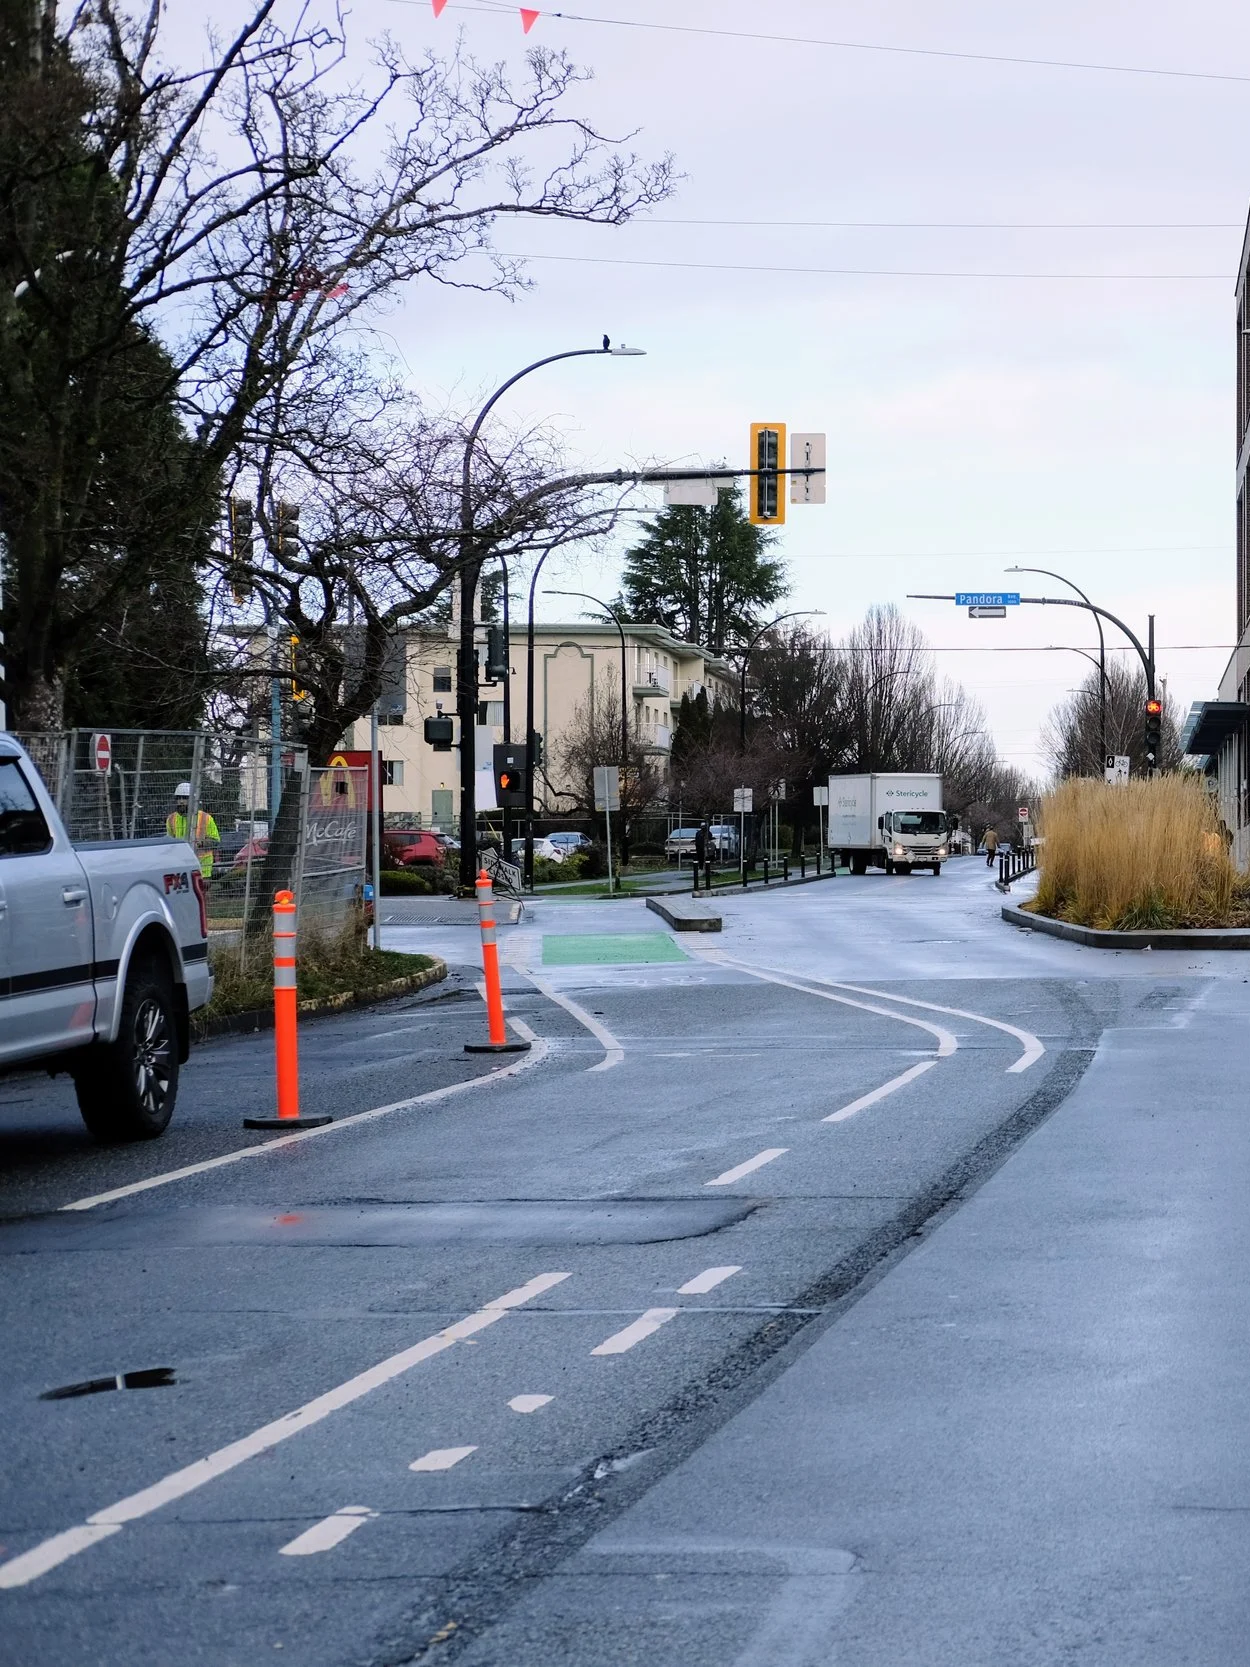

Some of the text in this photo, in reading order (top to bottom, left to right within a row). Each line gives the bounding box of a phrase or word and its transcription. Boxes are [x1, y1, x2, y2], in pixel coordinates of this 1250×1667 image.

[960, 594, 1003, 604] Pandora
[895, 790, 928, 799] Stericycle
[163, 872, 189, 895] FX4
